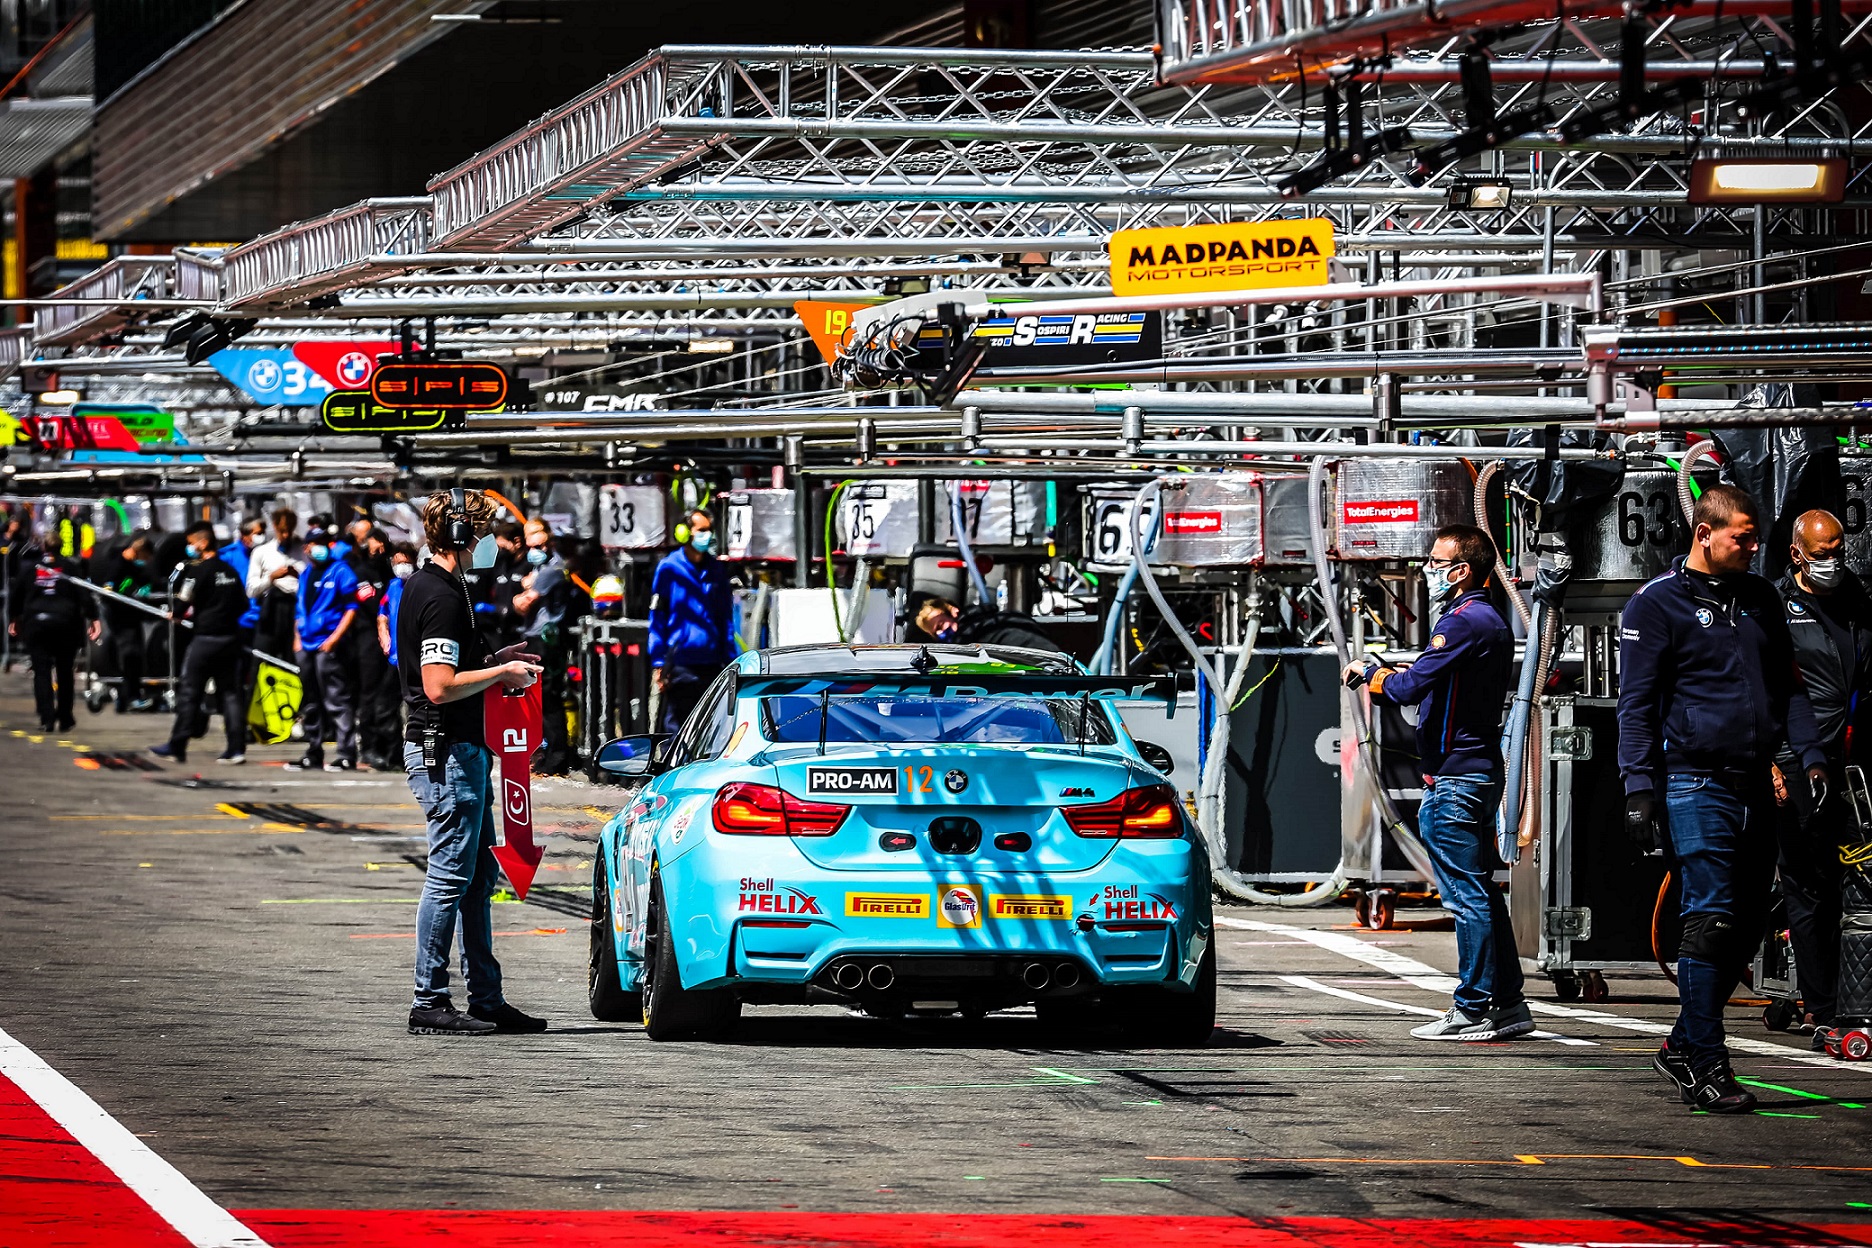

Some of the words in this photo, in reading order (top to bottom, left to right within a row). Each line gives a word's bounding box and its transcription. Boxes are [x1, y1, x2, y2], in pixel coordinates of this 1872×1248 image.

[1128, 236, 1320, 267] MADPANDA
[1128, 260, 1321, 282] MOTORSPORT
[825, 309, 846, 335] 19
[610, 502, 635, 534] 33
[850, 504, 876, 540] 35
[1167, 517, 1218, 529] TotalEnergies
[1346, 506, 1414, 518] TotalEnergies
[1618, 491, 1674, 547] 63
[503, 728, 528, 753] 12
[812, 772, 893, 790] PRO-AM
[903, 765, 934, 793] 12
[739, 877, 774, 892] Shell
[1104, 885, 1138, 899] Shell
[738, 892, 820, 915] HELIX
[853, 896, 922, 914] PIRELLI
[996, 898, 1064, 916] PIRELLI
[1104, 900, 1178, 920] HELIX
